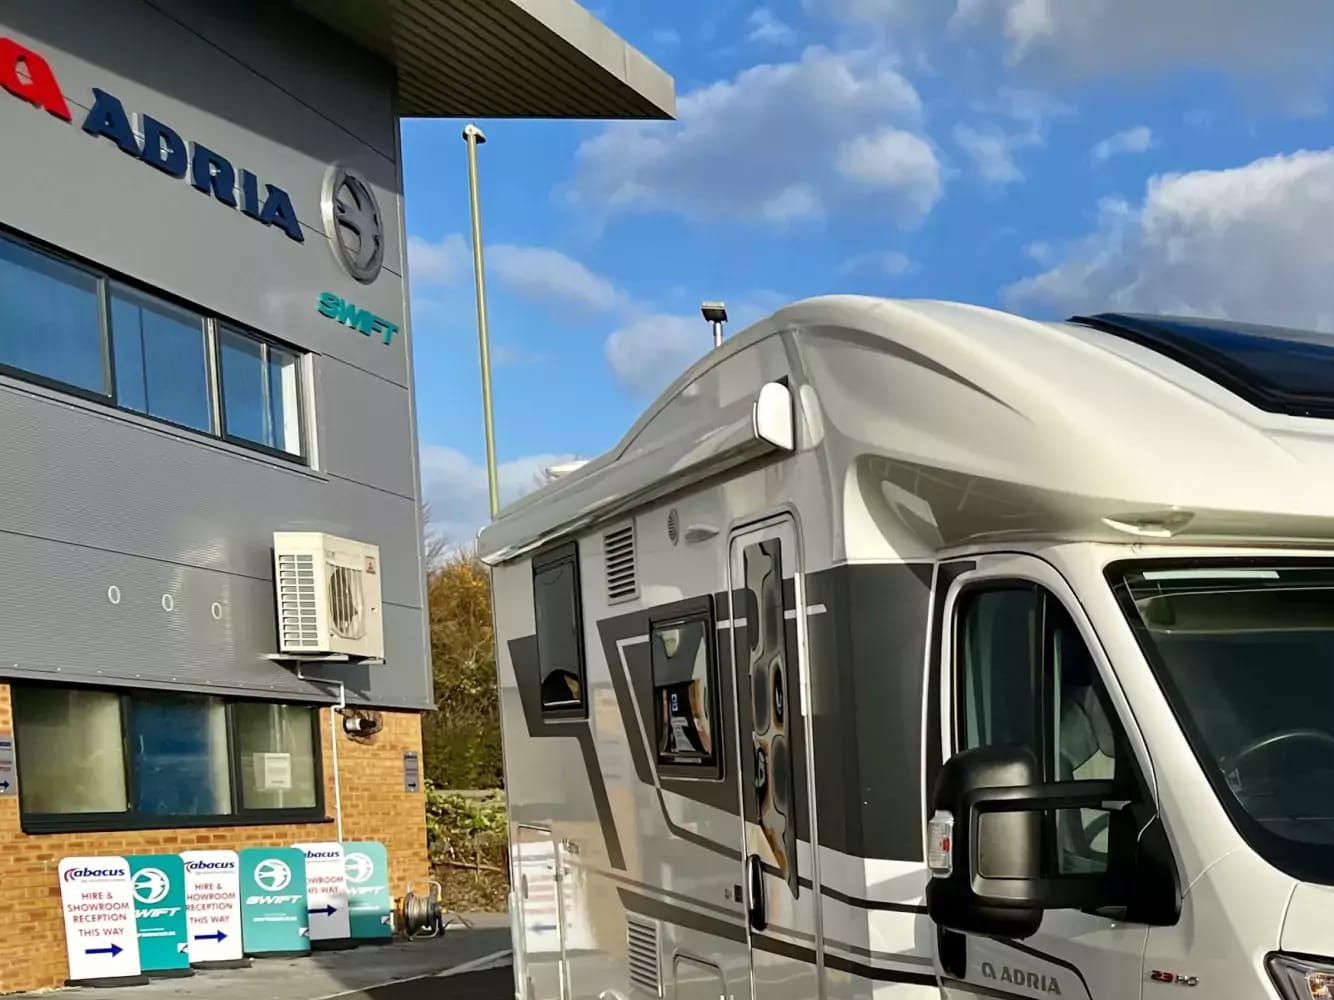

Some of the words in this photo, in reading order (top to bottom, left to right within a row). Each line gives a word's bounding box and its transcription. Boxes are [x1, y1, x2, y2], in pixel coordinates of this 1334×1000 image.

[82, 87, 304, 244] ADRIA
[317, 291, 399, 345] SWIFT
[189, 860, 235, 870] abacus
[73, 867, 126, 877] abacus
[194, 883, 214, 891] HIRE
[321, 886, 339, 894] WAY
[81, 892, 103, 900] HIRE
[106, 892, 113, 900] &
[186, 892, 236, 901] HOWROOM
[246, 895, 303, 905] SWIFT
[67, 902, 130, 912] SHOWROOM
[73, 913, 127, 923] RECEPTION
[135, 907, 181, 919] WIFT
[189, 916, 209, 924] THIS
[210, 915, 230, 923] WAY
[78, 929, 100, 937] THIS
[103, 927, 124, 936] WAY
[1000, 966, 1062, 996] ADRIA
